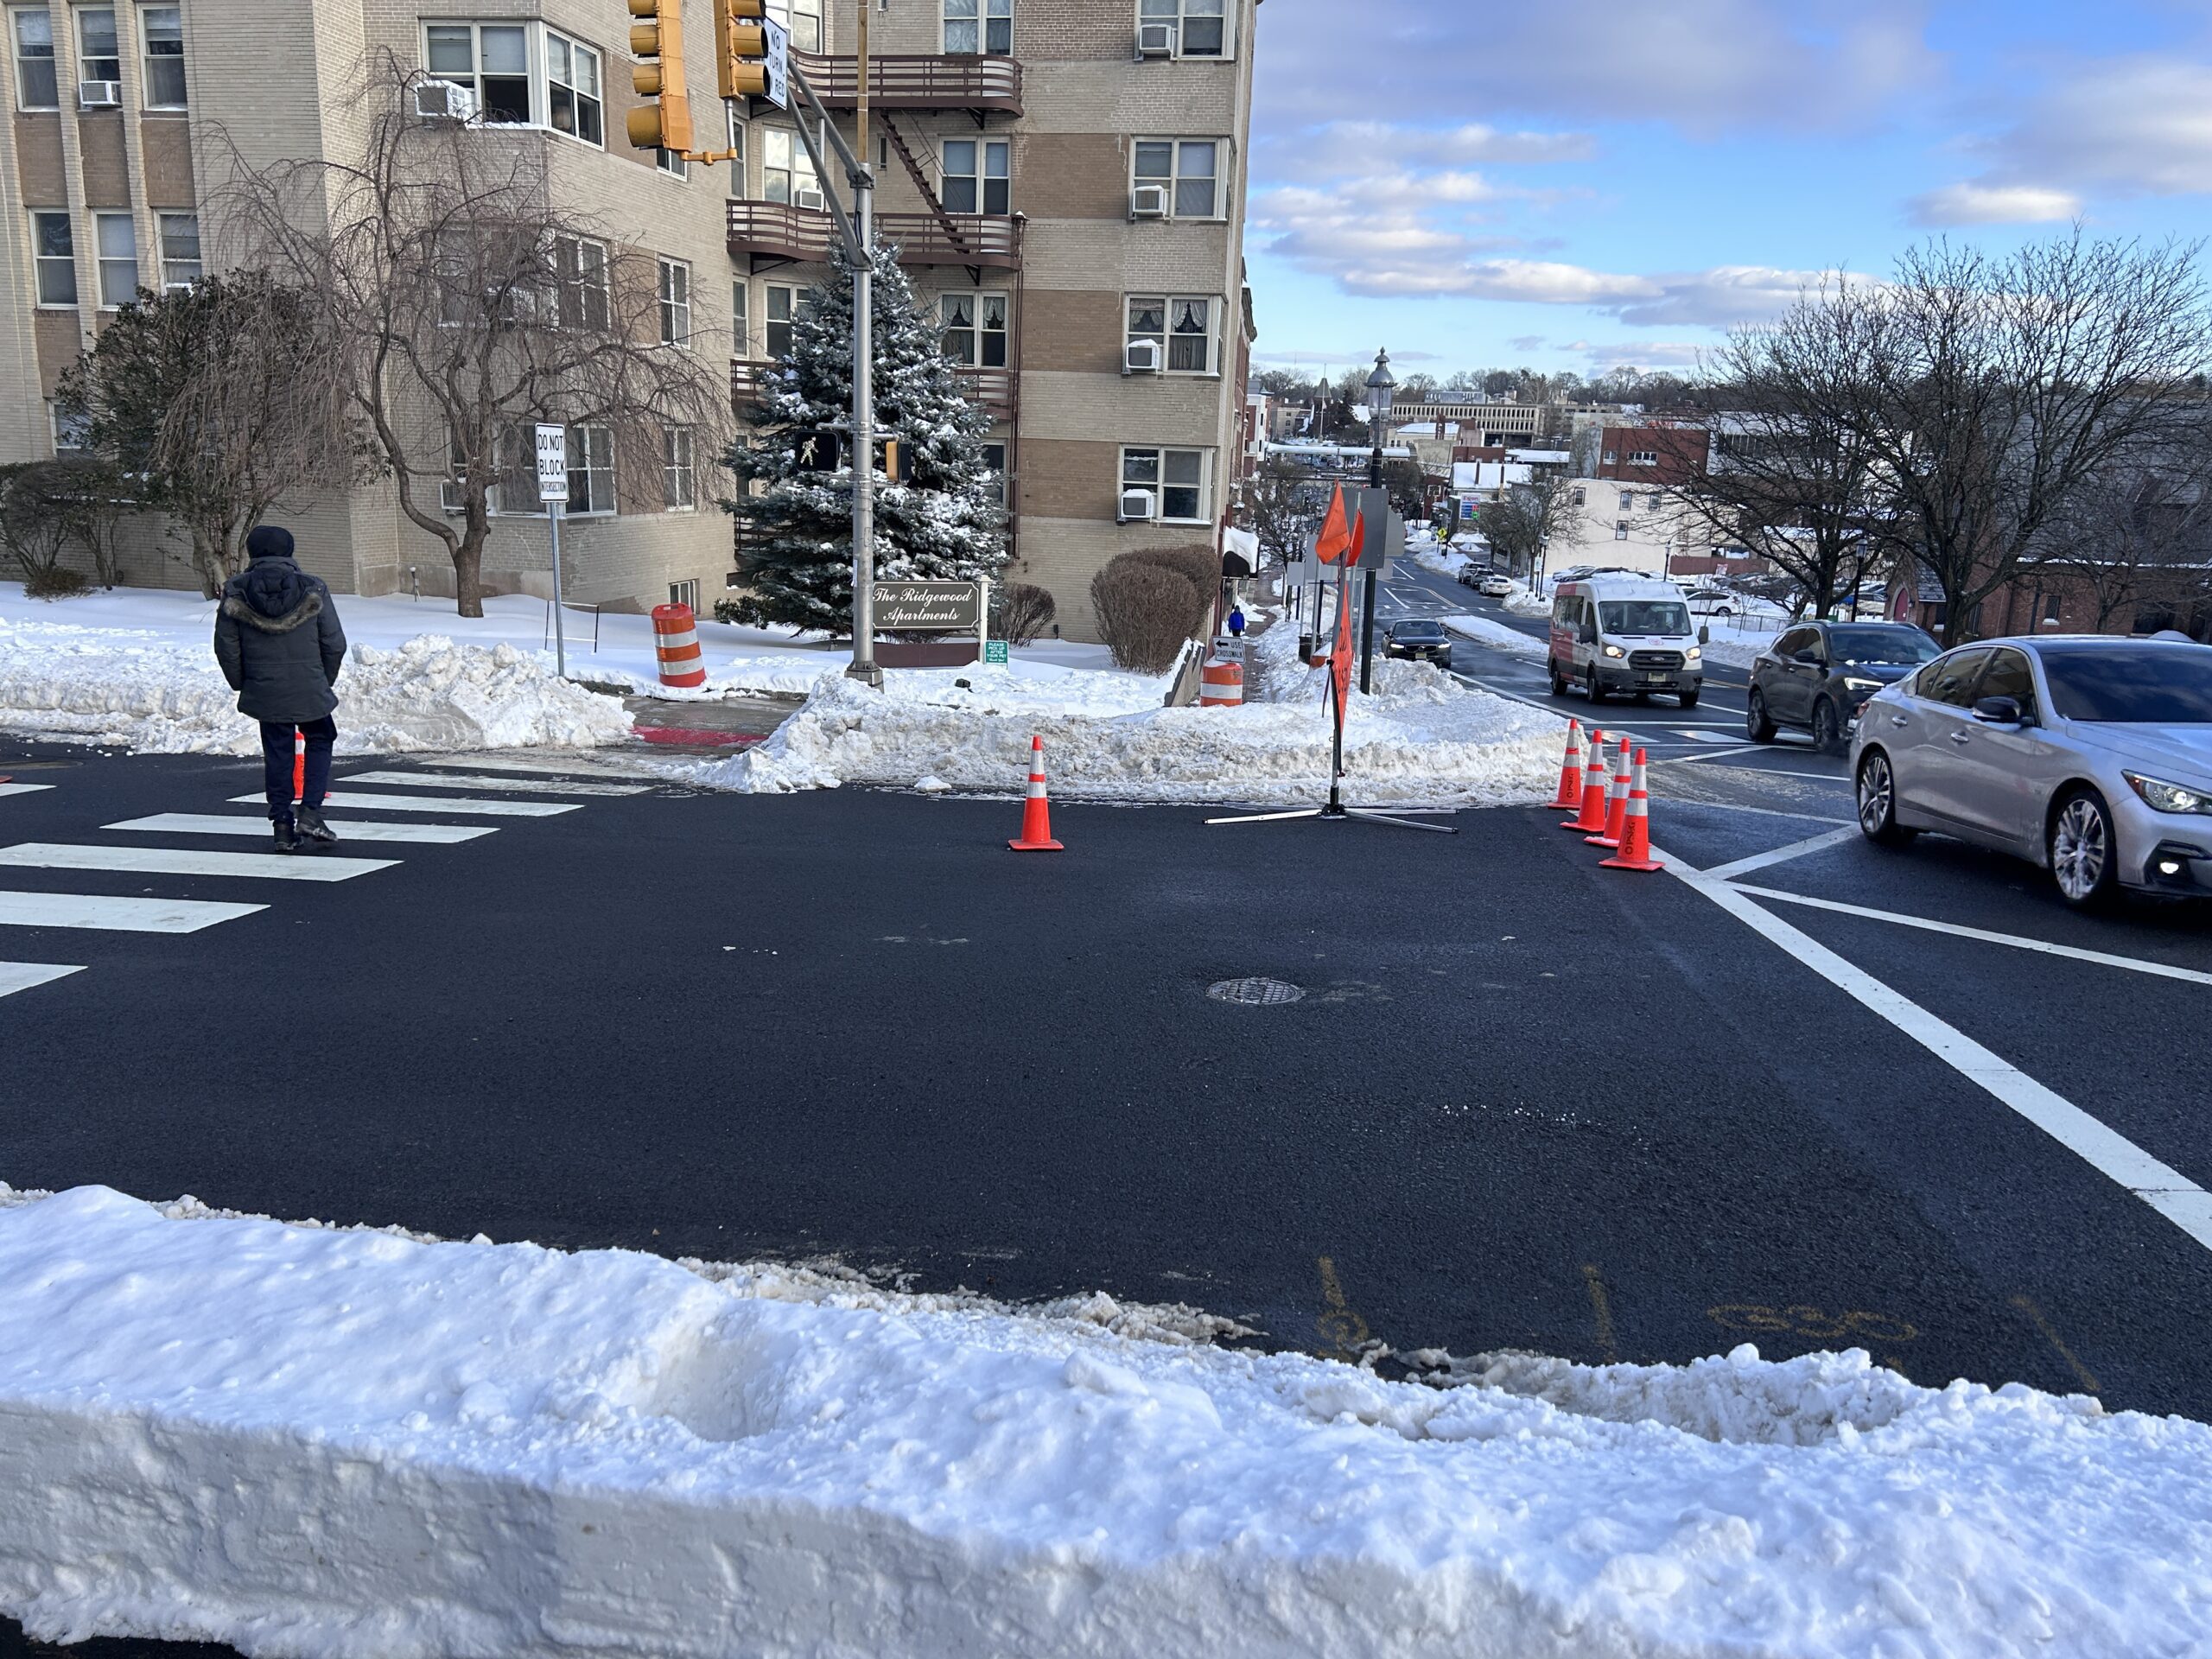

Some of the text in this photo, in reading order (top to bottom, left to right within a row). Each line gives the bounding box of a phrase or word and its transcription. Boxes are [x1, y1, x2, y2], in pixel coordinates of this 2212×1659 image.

[772, 30, 780, 50] NO
[769, 51, 783, 74] TURN
[775, 78, 785, 98] RED
[538, 434, 563, 451] DO NOT
[539, 459, 566, 476] BLOCK
[873, 588, 973, 607] The Ridgewood
[883, 607, 960, 626] Apartments
[1217, 650, 1243, 658] CROSSWALK
